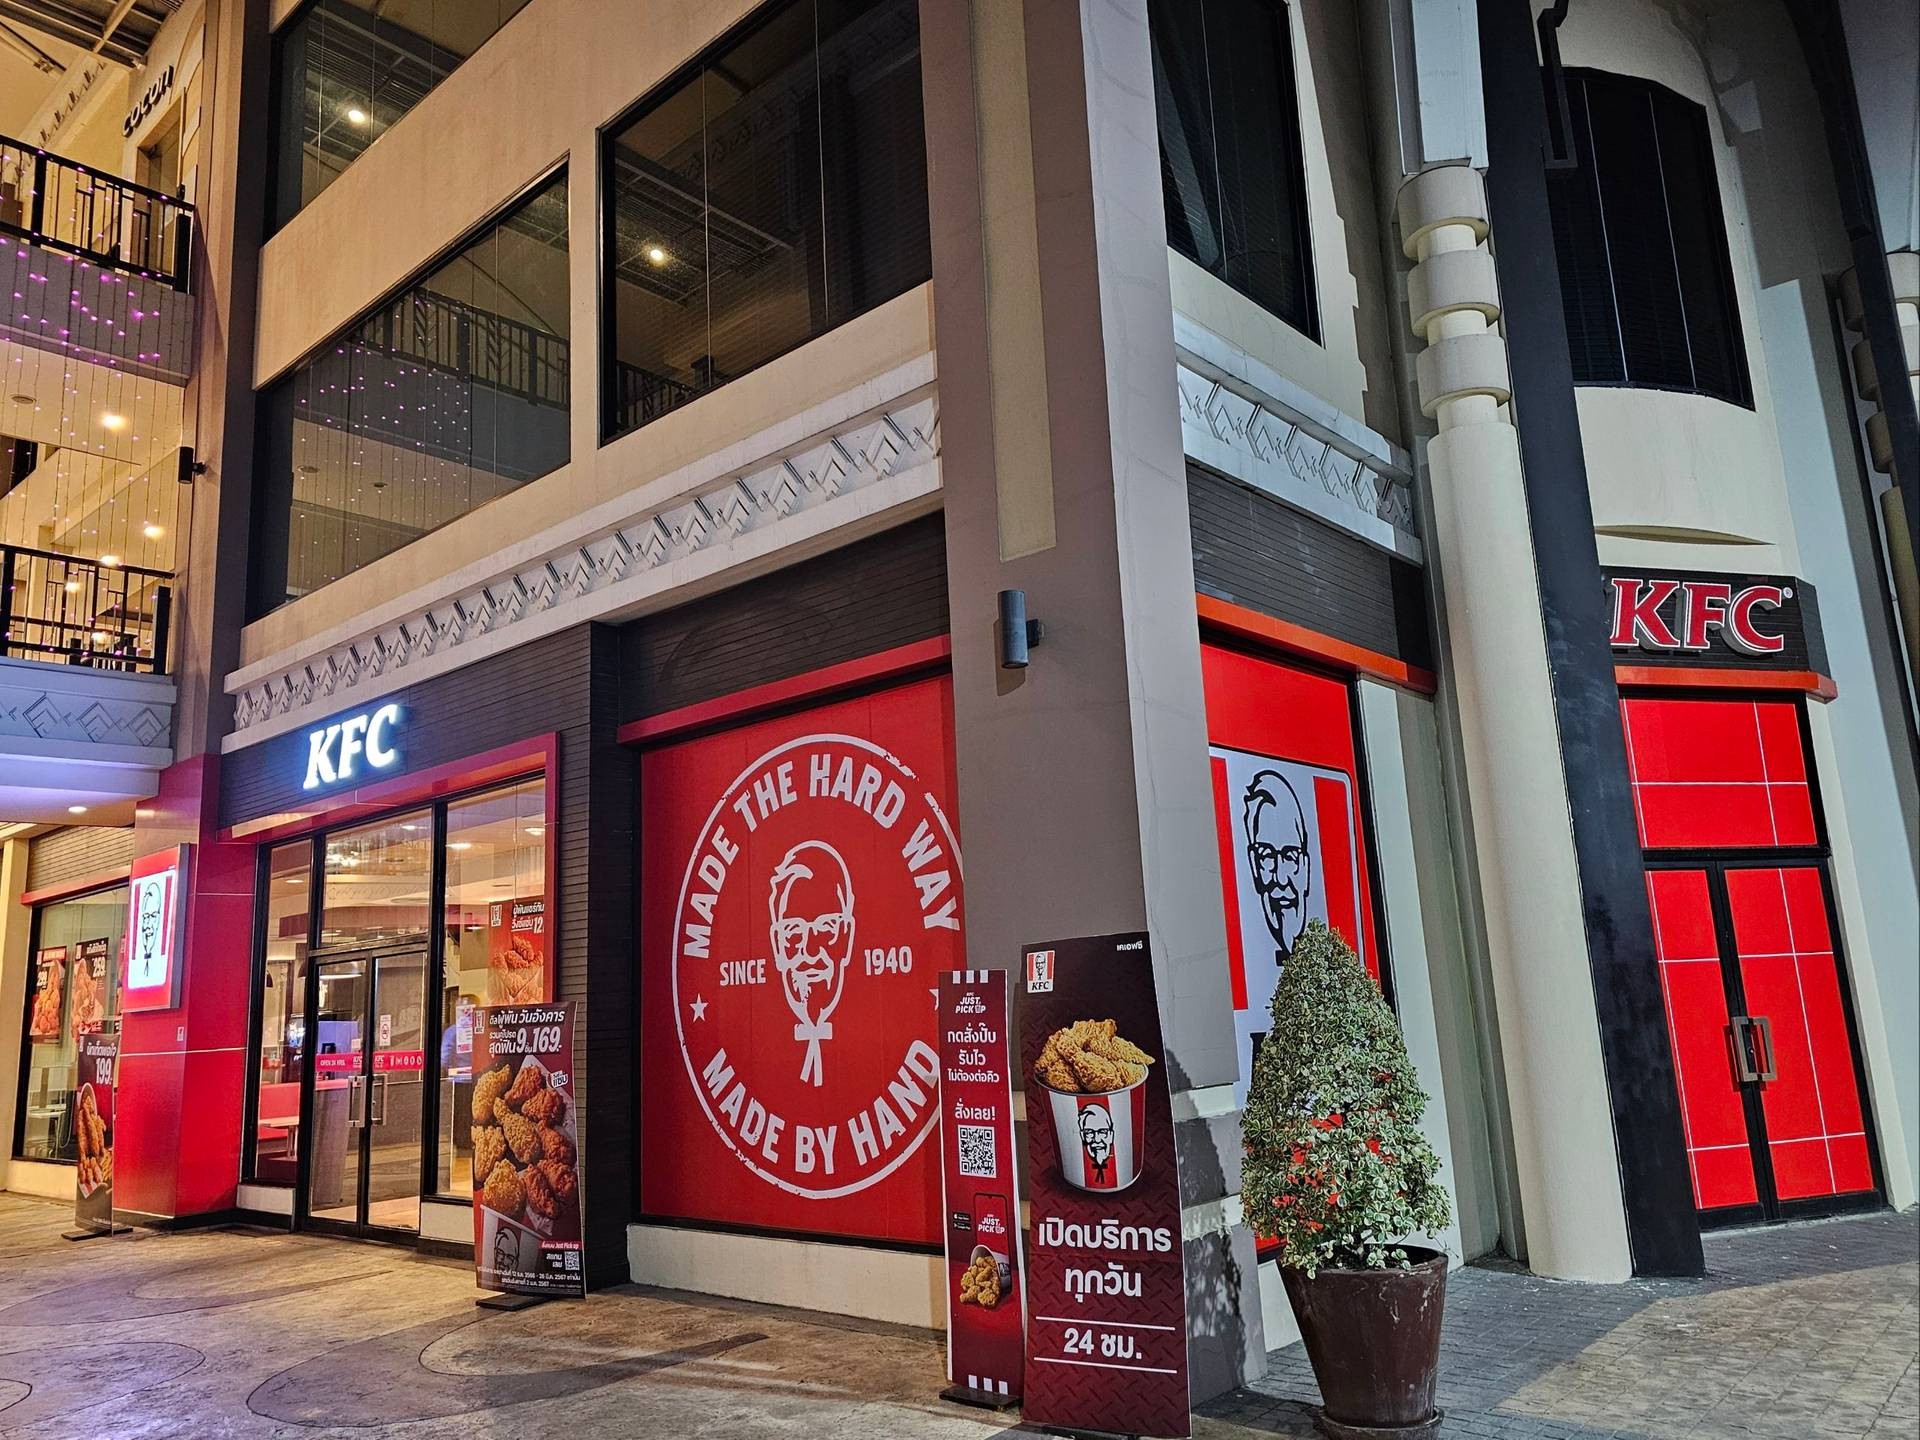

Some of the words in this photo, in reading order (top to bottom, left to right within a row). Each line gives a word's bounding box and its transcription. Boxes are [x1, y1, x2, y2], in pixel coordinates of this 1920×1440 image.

[1610, 579, 1784, 652] KFC
[303, 704, 398, 789] KFC
[684, 825, 740, 959] MADE
[734, 761, 798, 832] THE
[809, 753, 906, 829] HARD
[902, 818, 960, 932] WAY
[1116, 940, 1142, 952] เคเอฟซี
[720, 958, 766, 986] SINCE
[864, 946, 912, 976] 1940
[1032, 981, 1050, 990] KFC
[519, 1008, 565, 1024] วันอังคาร
[955, 1006, 974, 1014] PICK
[516, 1028, 527, 1054] 9
[948, 1022, 996, 1044] กดสั่งปั๊บ
[958, 1049, 986, 1066] รับไว
[948, 1068, 1000, 1082] ไม่ต้องต่อคิว
[702, 1047, 785, 1163] MADE
[796, 1125, 837, 1175] BY
[848, 1039, 940, 1166] HAND
[954, 1098, 996, 1120] สั่งเลย!
[978, 1224, 994, 1232] PICK
[1038, 1217, 1172, 1252] เปิดบริการ
[1065, 1262, 1142, 1302] ทุกวัน
[1064, 1328, 1094, 1354] 24
[1100, 1334, 1142, 1359] ชม.
